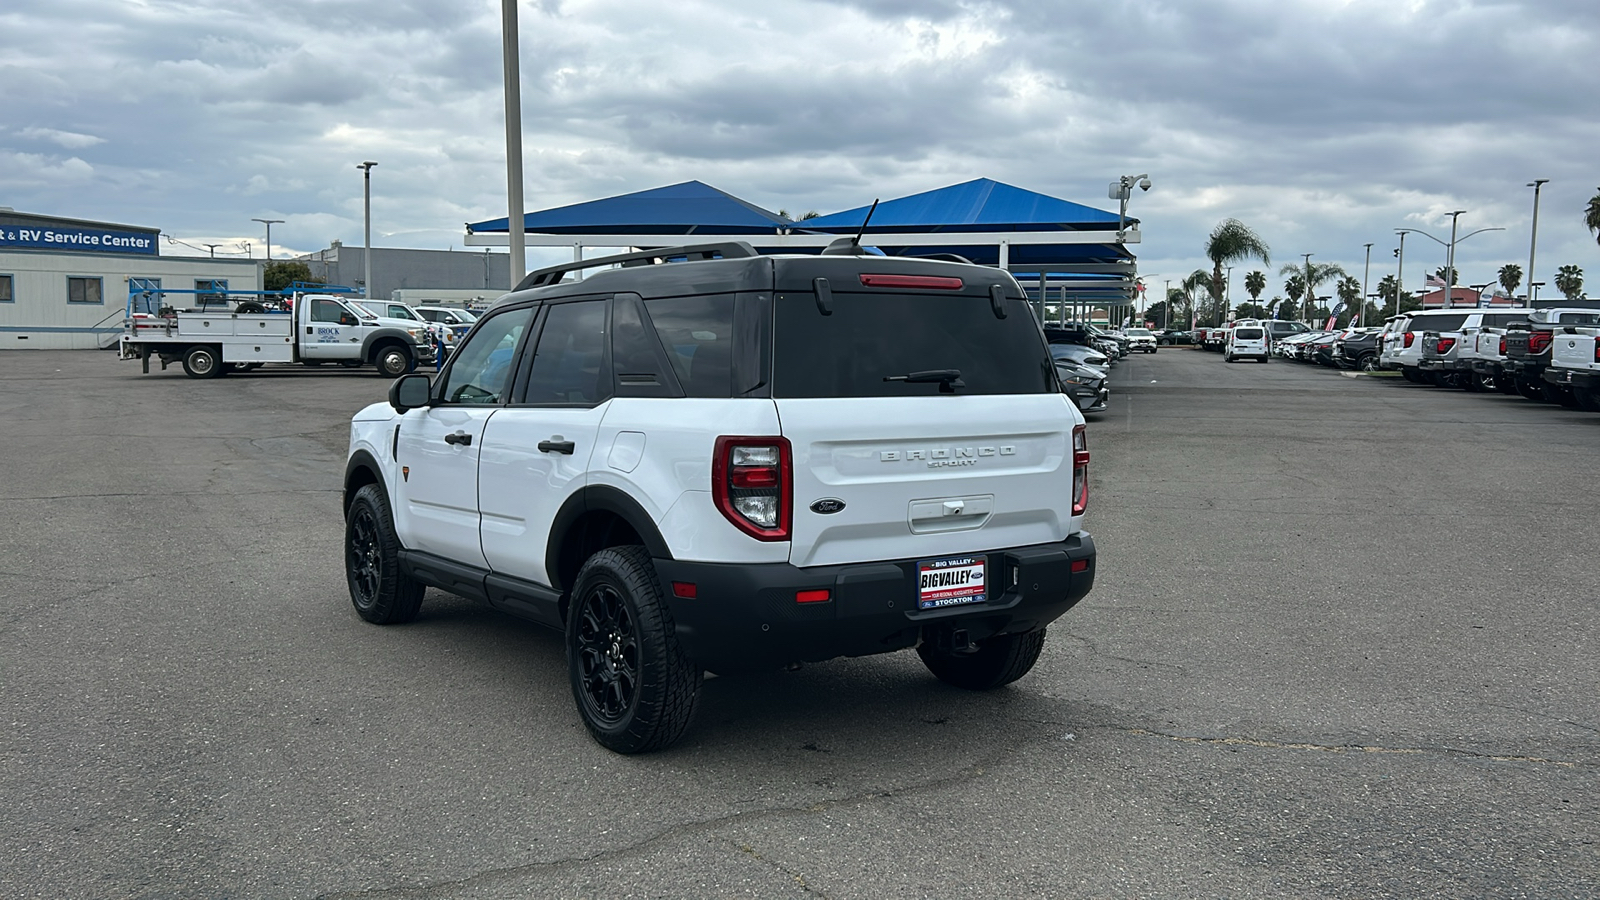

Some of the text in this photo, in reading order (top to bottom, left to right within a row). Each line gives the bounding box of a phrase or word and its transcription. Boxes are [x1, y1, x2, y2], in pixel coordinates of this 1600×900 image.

[7, 231, 16, 240] &
[19, 229, 41, 241] RV
[44, 231, 99, 245] Service
[102, 234, 150, 248] Center
[317, 327, 340, 335] BROCK
[880, 445, 1016, 462] BRONCO
[927, 458, 977, 468] SPORT
[948, 558, 972, 566] VALLEY
[921, 569, 972, 588] BIGVALLEY
[935, 596, 973, 606] STOCKTON
